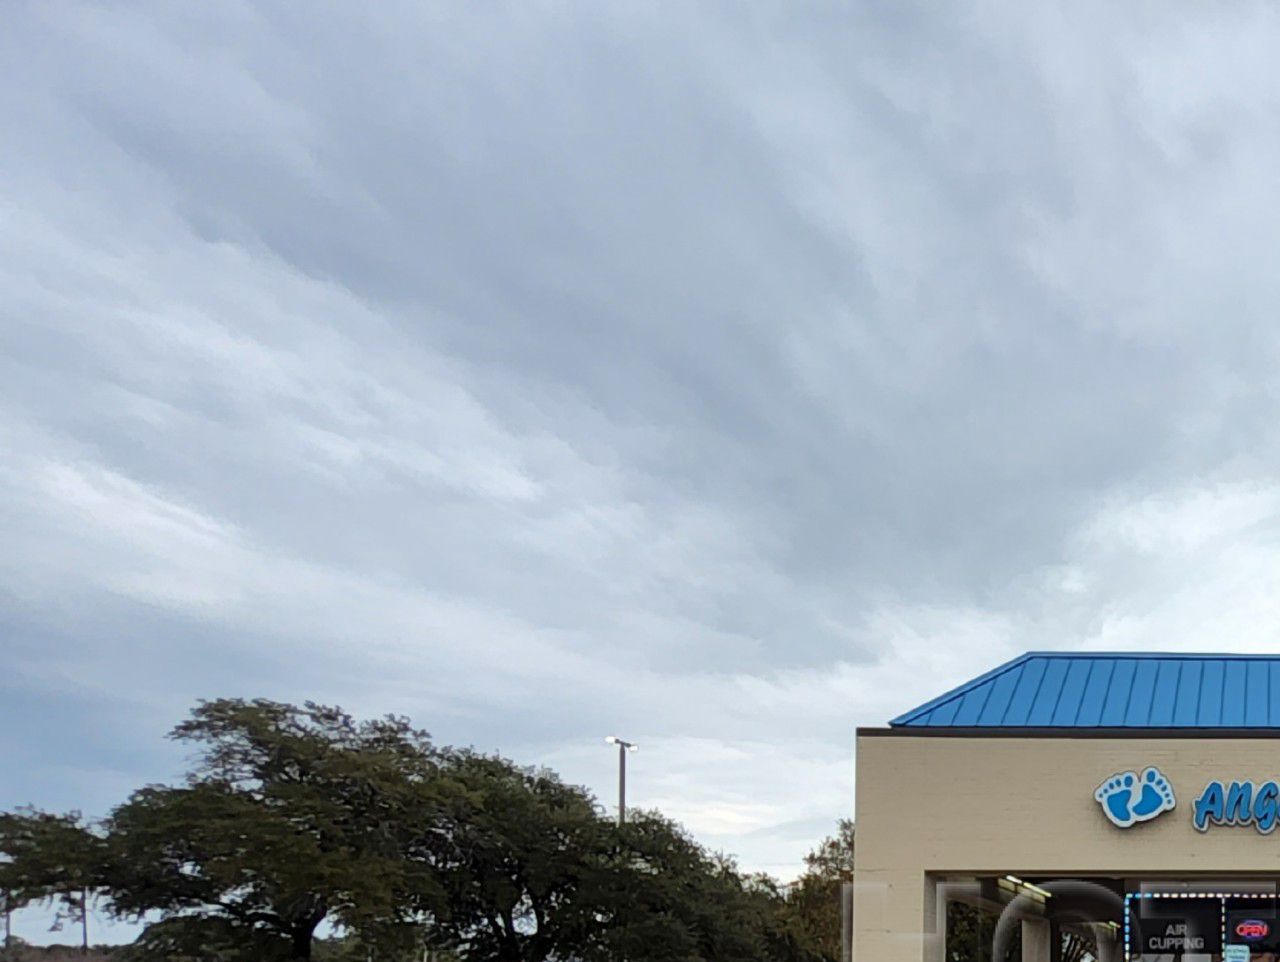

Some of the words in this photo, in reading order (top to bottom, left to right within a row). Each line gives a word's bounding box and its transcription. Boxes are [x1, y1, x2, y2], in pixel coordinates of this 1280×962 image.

[1165, 924, 1188, 936] AIR
[1236, 922, 1268, 937] OPEN
[1148, 936, 1205, 950] CUPPING
